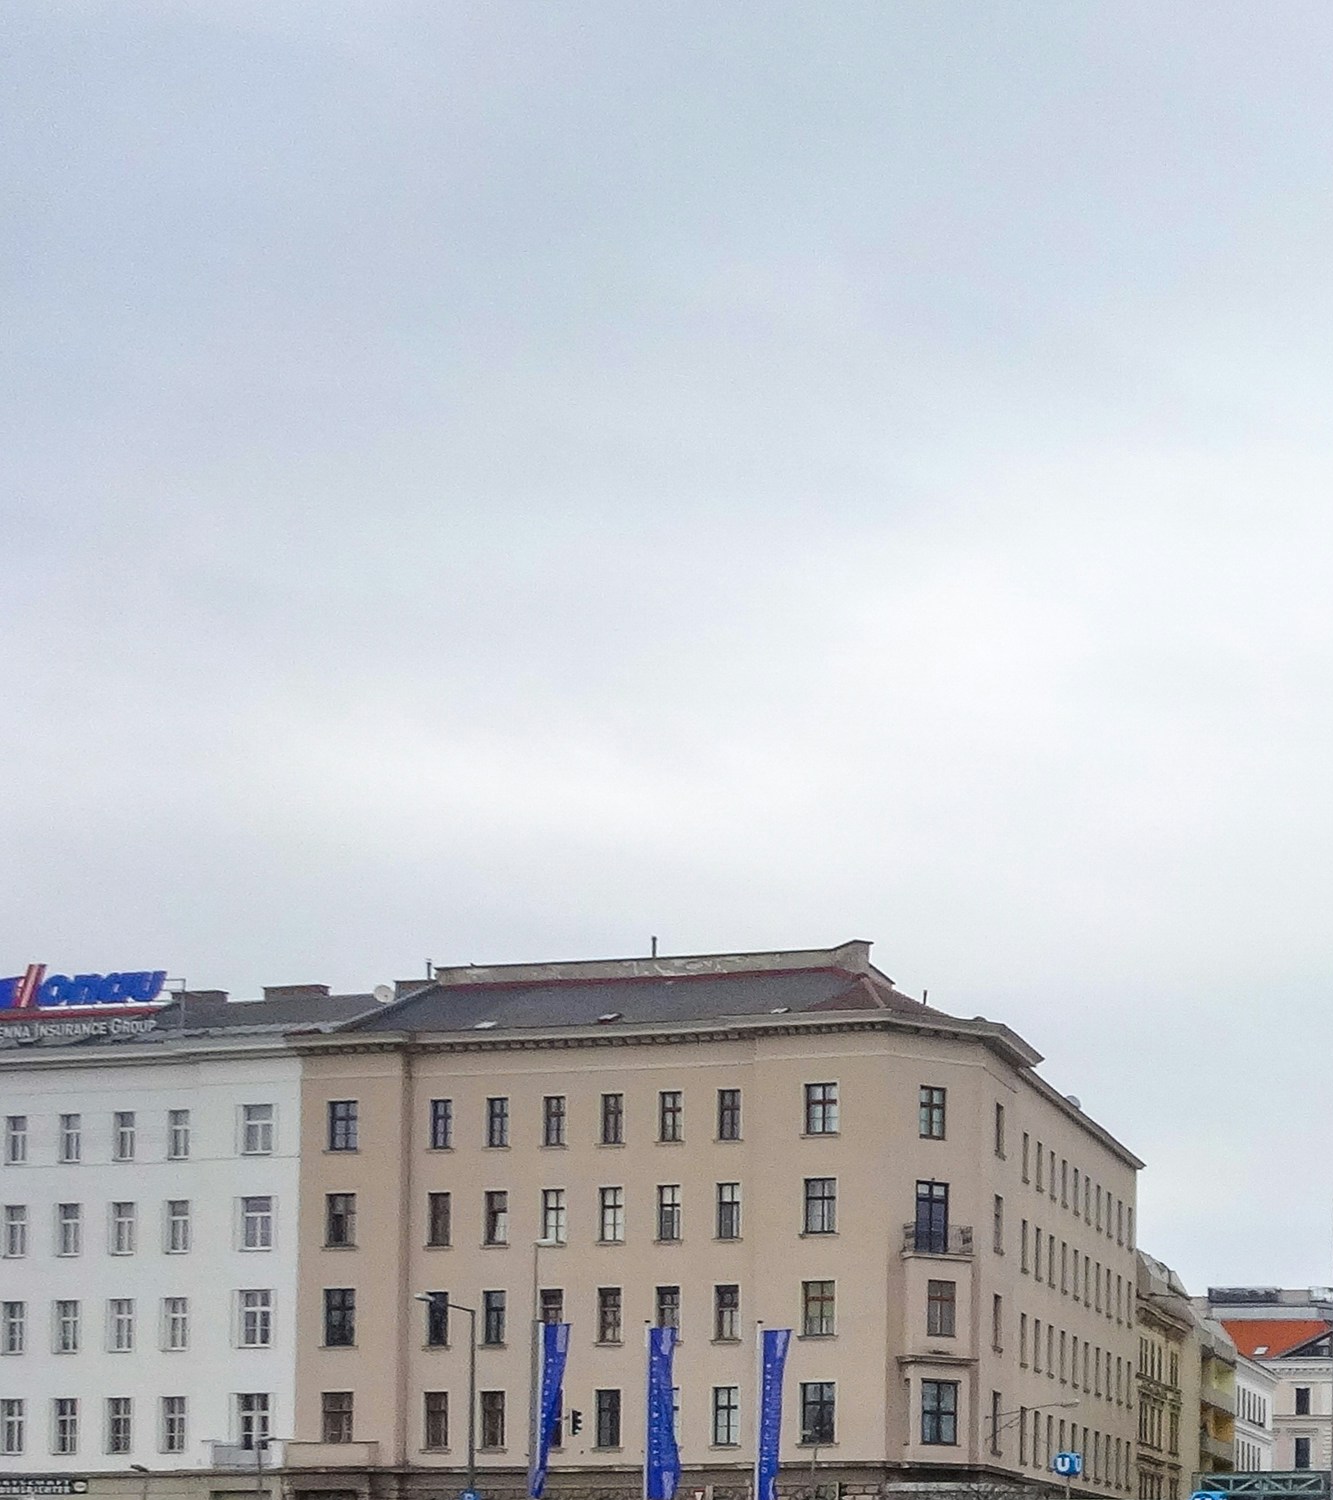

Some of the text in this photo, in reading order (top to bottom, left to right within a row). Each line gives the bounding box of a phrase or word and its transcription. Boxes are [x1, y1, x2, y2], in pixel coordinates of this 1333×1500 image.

[35, 1022, 108, 1037] INSURANCE
[111, 1018, 158, 1035] GROUP
[1056, 1457, 1070, 1472] U
